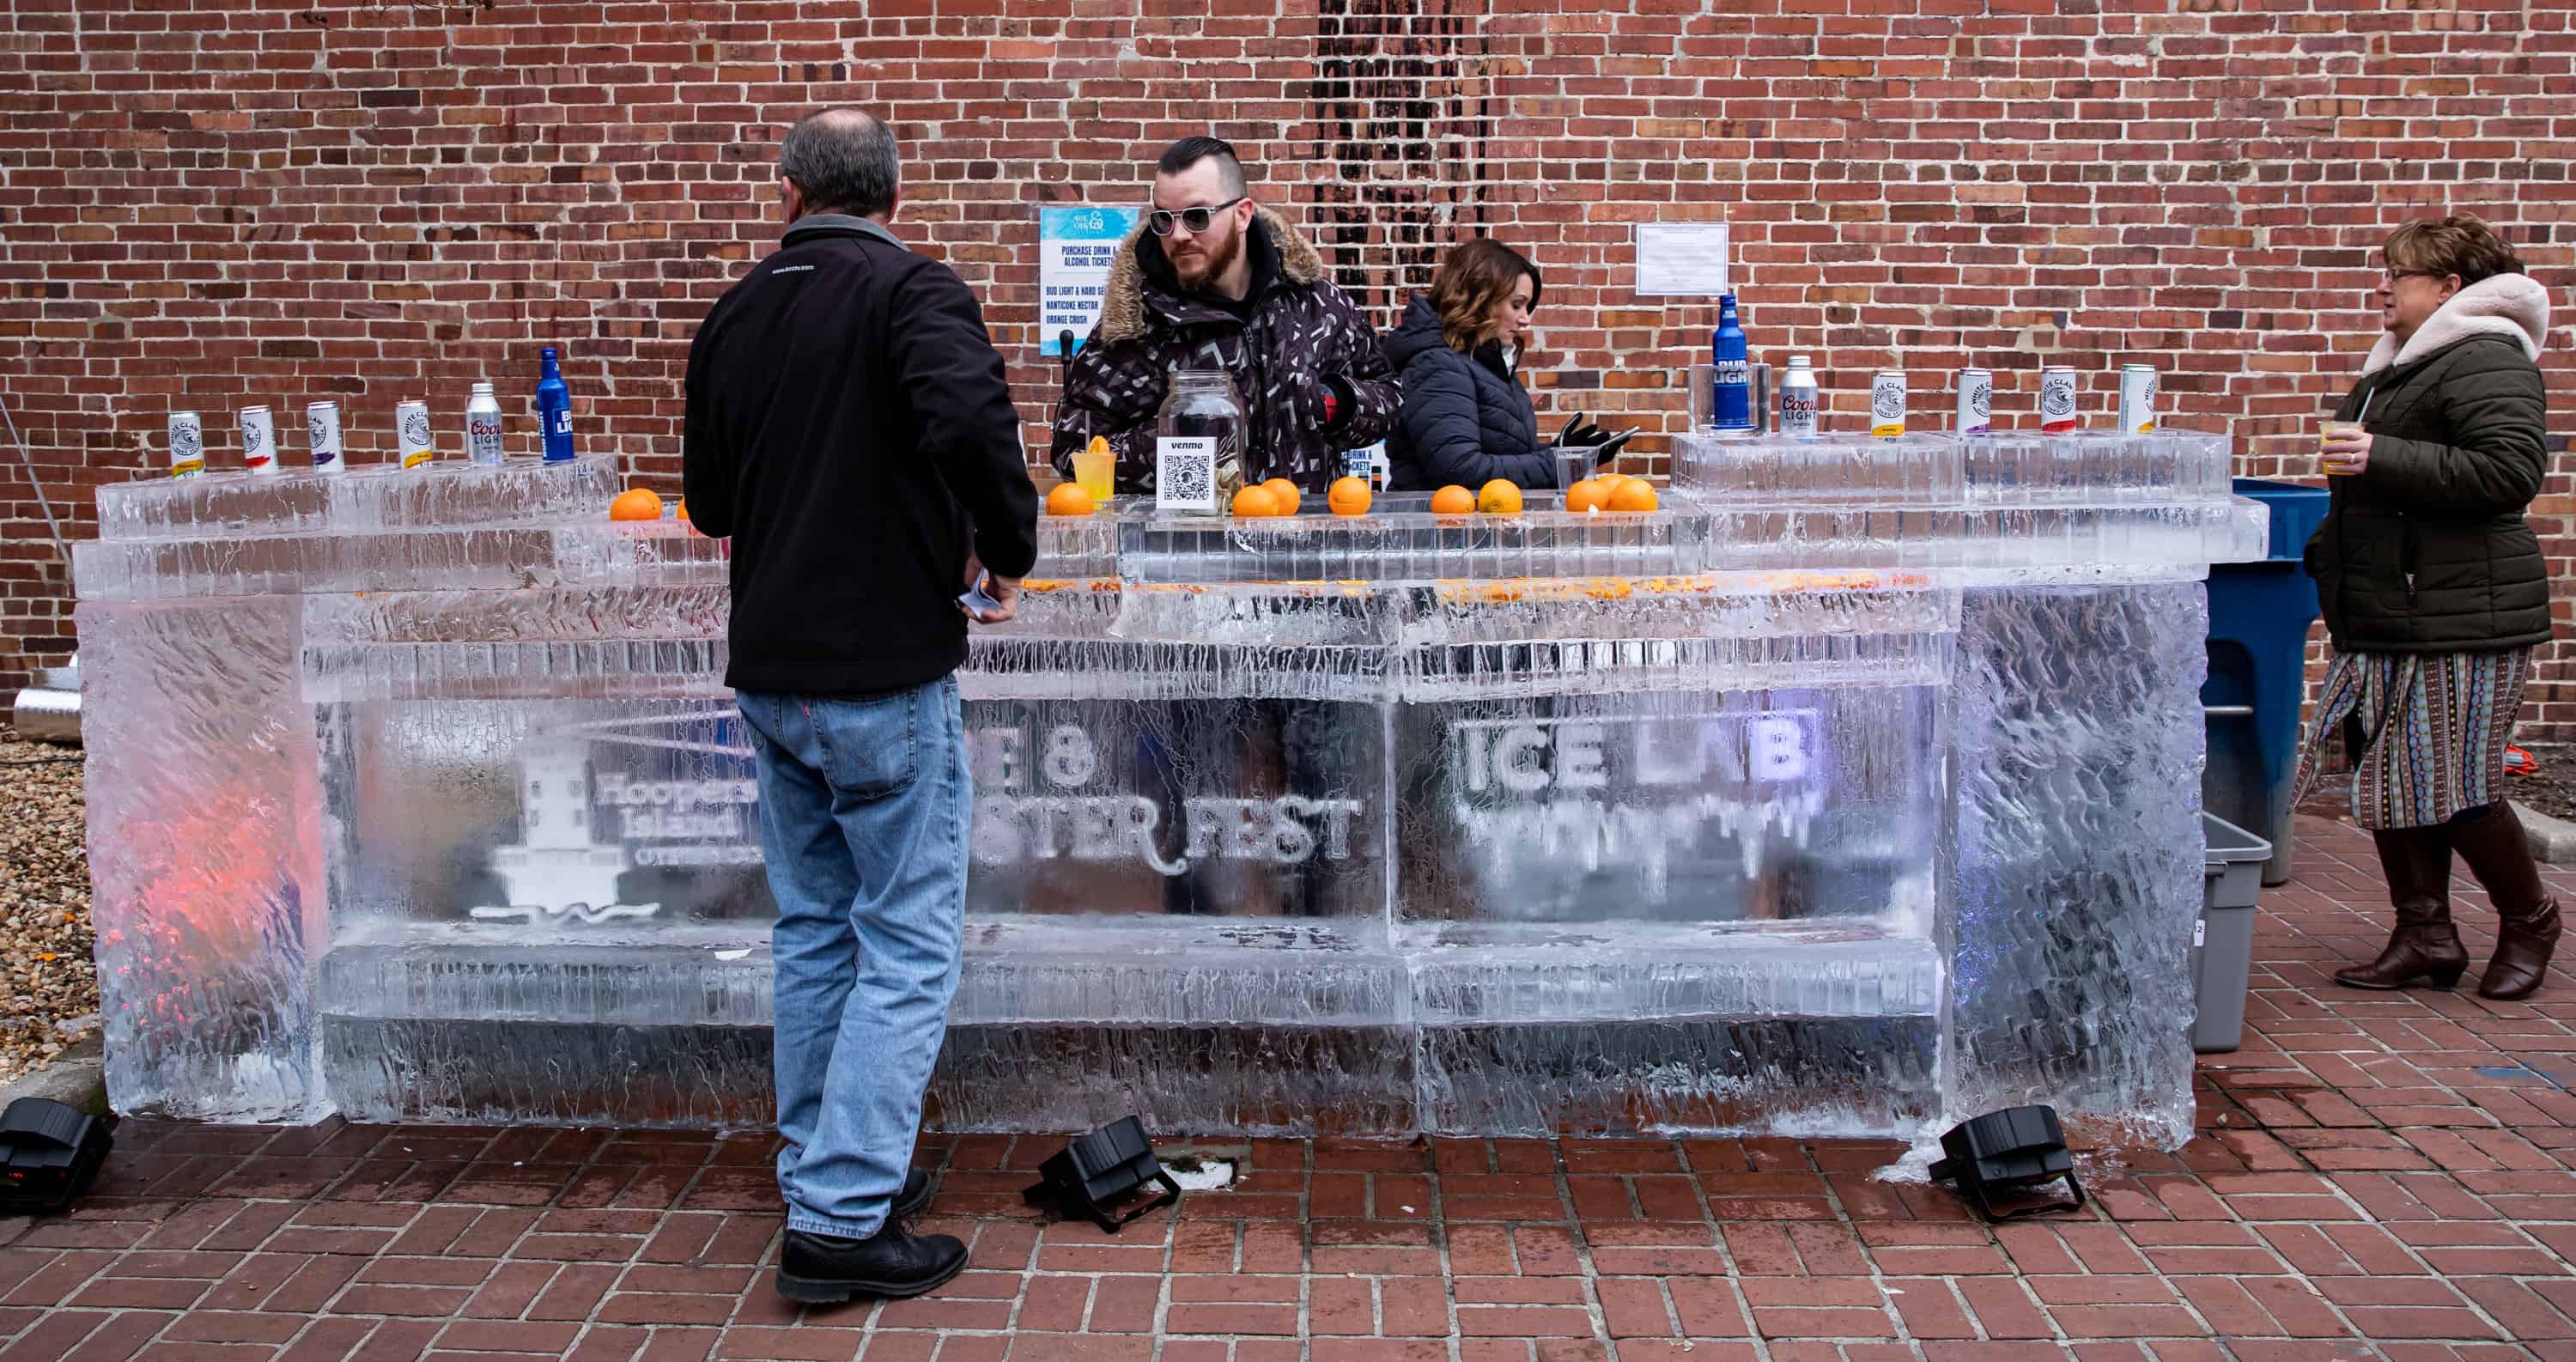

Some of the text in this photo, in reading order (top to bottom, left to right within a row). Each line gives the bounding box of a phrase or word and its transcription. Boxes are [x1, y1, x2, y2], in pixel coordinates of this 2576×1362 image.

[1061, 246, 1091, 255] PURCHASE
[1093, 246, 1111, 255] DRINK
[1064, 257, 1090, 267] ALCOHOL
[1046, 286, 1057, 296] BUD
[1059, 286, 1074, 296] LIGHT
[1081, 286, 1097, 296] HARD
[1046, 301, 1098, 310] NANTICOKE NECTAR
[1046, 315, 1088, 325] ORANGE CRUSH
[1713, 360, 1747, 384] BUD LIGH
[1783, 394, 1818, 411] Coor
[471, 420, 501, 435] Coor
[1171, 441, 1203, 450] venmo
[1465, 726, 1609, 790] ICE
[970, 794, 1364, 876] STER FEST
